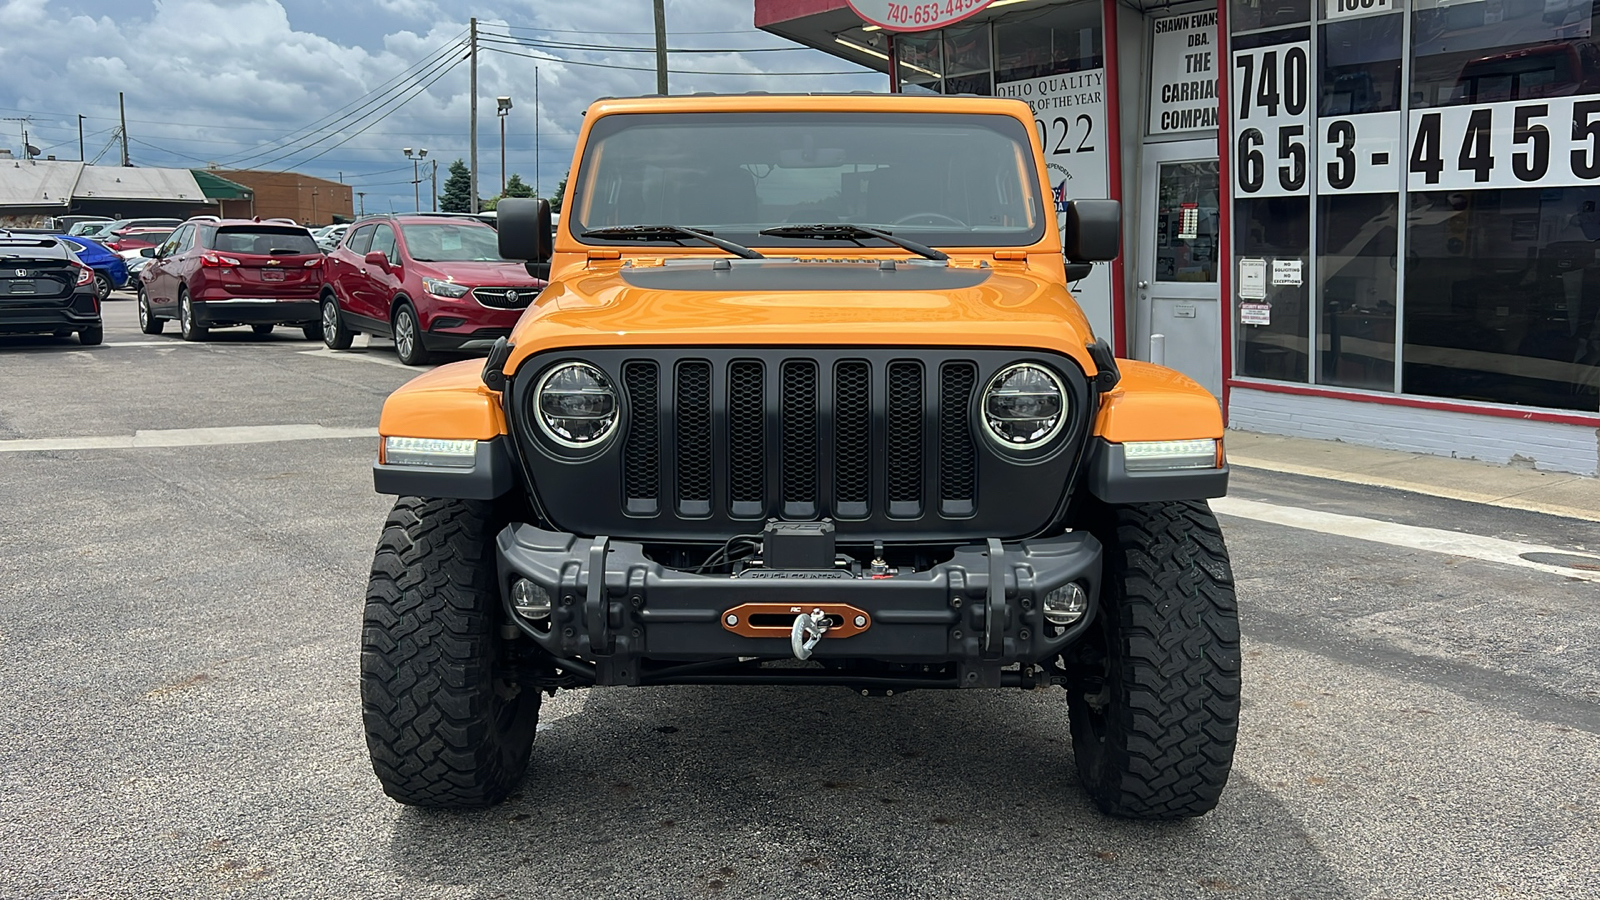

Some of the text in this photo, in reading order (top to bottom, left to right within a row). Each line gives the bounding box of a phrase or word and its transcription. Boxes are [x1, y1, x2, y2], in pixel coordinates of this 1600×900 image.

[887, 0, 981, 24] 740-653-44
[1155, 16, 1189, 34] SHAWN
[1188, 33, 1209, 47] DBA.
[1185, 52, 1211, 73] THE
[998, 83, 1032, 97] OHIO
[1038, 73, 1103, 95] QUALITY
[1162, 79, 1219, 103] CARRIA
[1236, 47, 1307, 120] 740
[1038, 98, 1050, 110] OF
[1052, 96, 1072, 108] THE
[1074, 91, 1102, 105] YEAR
[1161, 107, 1219, 130] COMPAN
[1035, 114, 1095, 155] 022
[1046, 163, 1073, 180] EPENDENT
